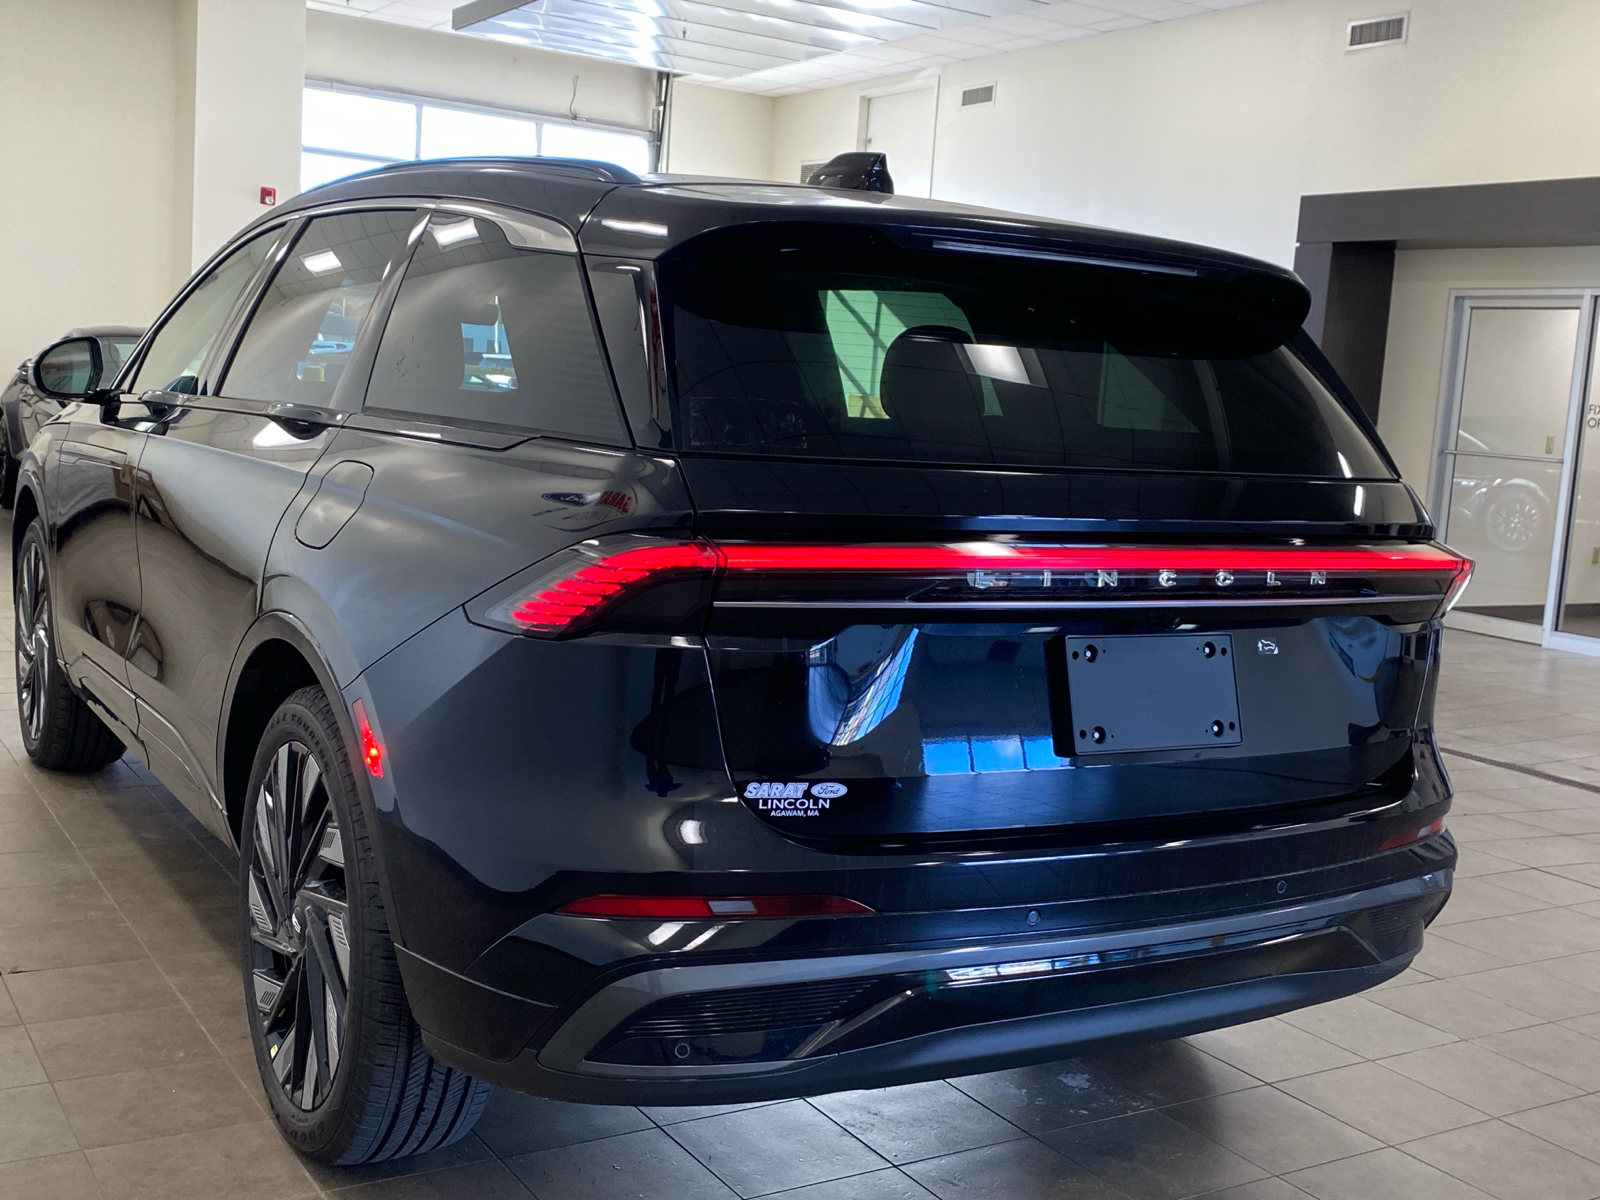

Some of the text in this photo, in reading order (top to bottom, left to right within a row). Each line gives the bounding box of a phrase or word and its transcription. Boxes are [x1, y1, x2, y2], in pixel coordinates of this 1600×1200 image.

[974, 569, 1327, 589] LINCOLN
[744, 782, 843, 799] SARAT Ford
[758, 799, 830, 809] LINCOLN
